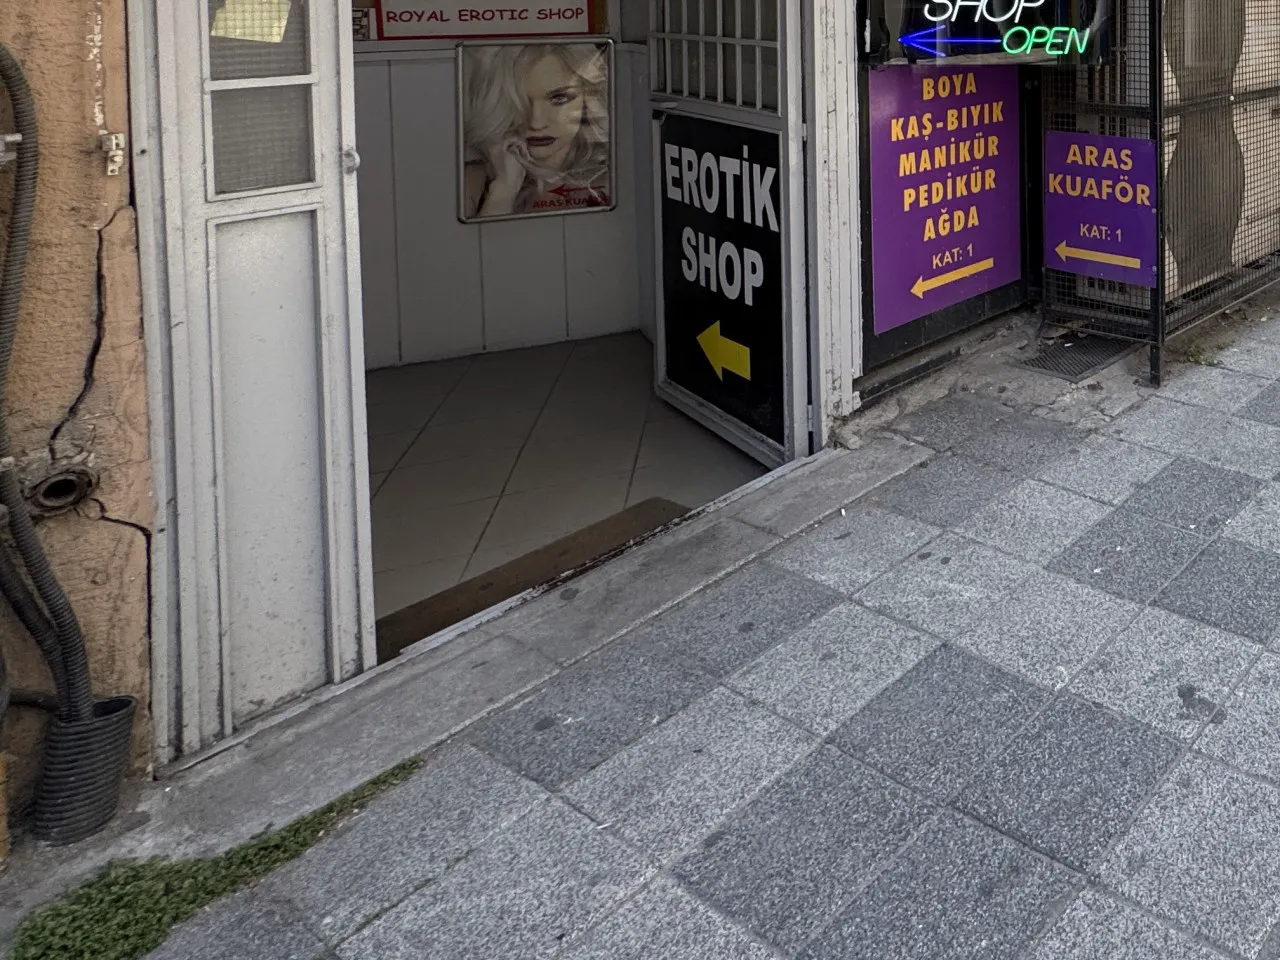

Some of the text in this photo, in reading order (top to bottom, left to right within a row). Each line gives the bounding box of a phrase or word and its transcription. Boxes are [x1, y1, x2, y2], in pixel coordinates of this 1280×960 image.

[386, 7, 585, 23] ROYAL EROTIC SHOP
[1002, 25, 1090, 56] OPEN
[922, 72, 977, 101] BOYA
[891, 101, 1004, 142] KAŞ-BIYIK
[898, 131, 999, 178] MANİKÜR
[1066, 144, 1133, 171] ARAS
[664, 141, 779, 233] EROTİK
[903, 166, 997, 212] PEDİKÜR
[1048, 173, 1151, 206] KUAFÖR
[923, 206, 980, 242] AĞDA
[1079, 223, 1122, 242] KAT: 1
[681, 226, 764, 307] SHOP
[932, 244, 974, 270] KAT: 1
